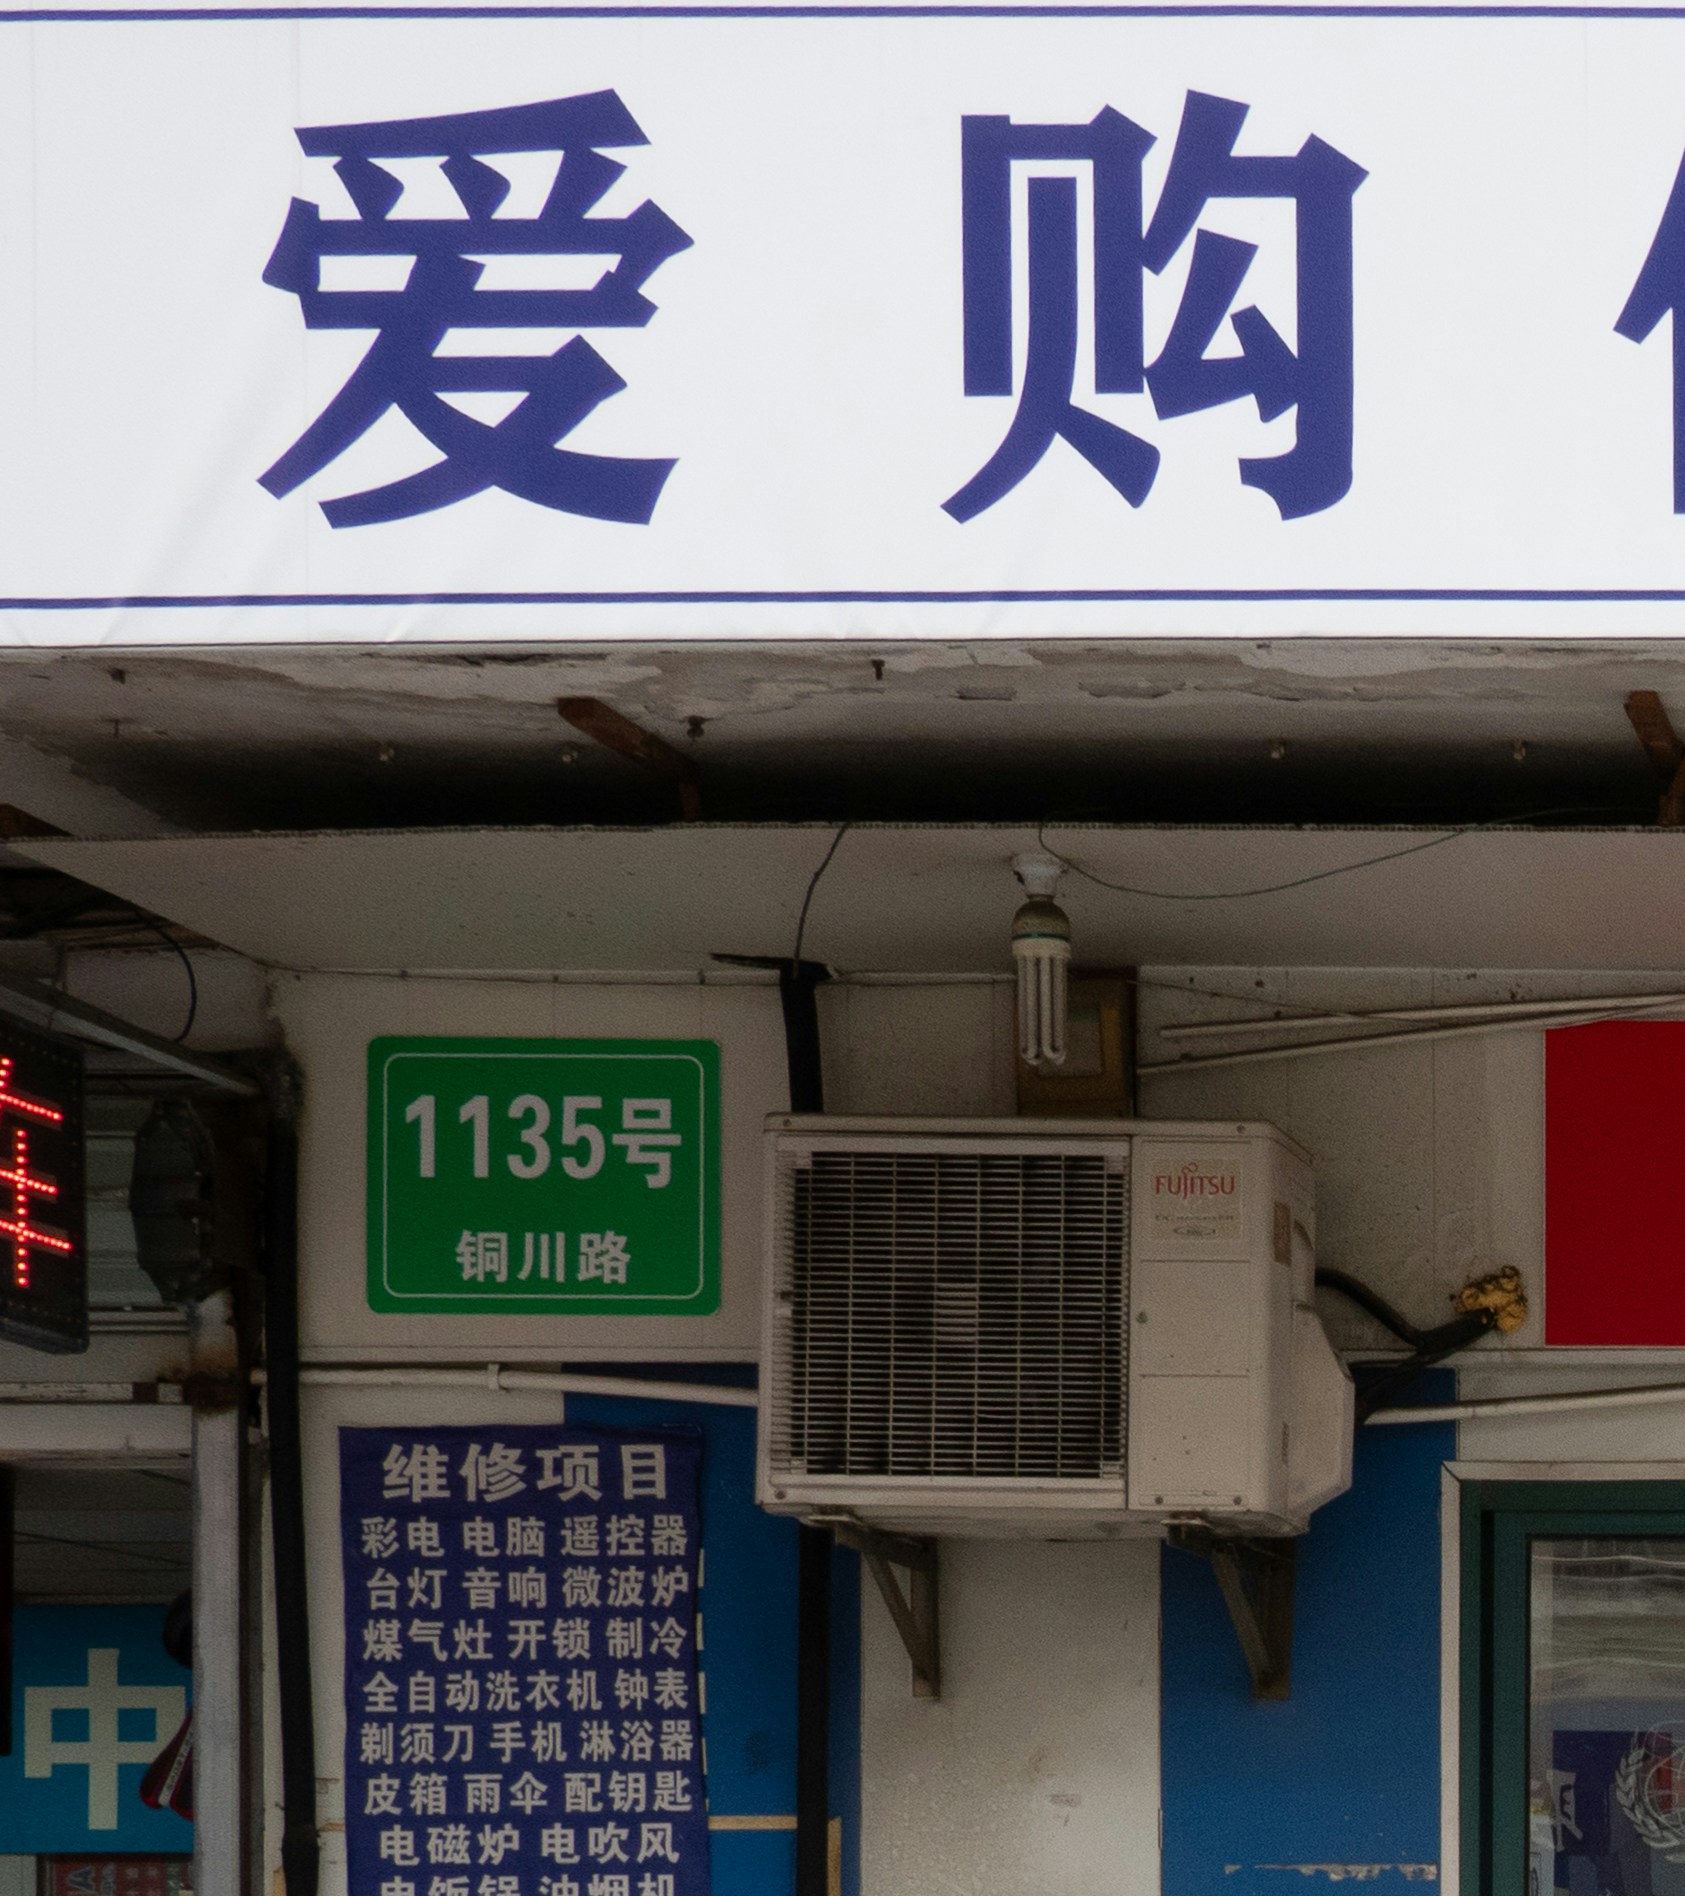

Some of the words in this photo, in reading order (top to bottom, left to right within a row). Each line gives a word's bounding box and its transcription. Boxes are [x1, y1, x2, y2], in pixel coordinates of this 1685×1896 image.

[403, 1093, 683, 1191] 1135号
[1154, 1164, 1236, 1199] FUJITSU
[455, 1228, 632, 1286] 铜川路
[382, 1443, 668, 1503] 维修项目
[360, 1516, 445, 1558] 彩电
[464, 1516, 545, 1558] 电脑
[561, 1515, 689, 1558] 遥控器
[366, 1567, 446, 1611] 台灯
[462, 1566, 547, 1610] 音响
[563, 1566, 689, 1607] 微波炉
[363, 1619, 493, 1662] 煤气灶
[507, 1619, 591, 1661] 开锁
[605, 1617, 688, 1660] 制冷
[363, 1670, 603, 1714] 全自动洗衣机
[614, 1669, 689, 1712] 钟表
[23, 1648, 188, 1830] 中
[360, 1722, 475, 1765] 剃须刀
[490, 1722, 567, 1763] 手机
[580, 1719, 694, 1762] 淋浴器
[364, 1774, 447, 1816] 皮箱
[464, 1772, 549, 1815] 雨伞
[564, 1771, 693, 1814] 配钥匙
[379, 1824, 520, 1866] 电磁炉
[542, 1822, 680, 1864] 电吹风
